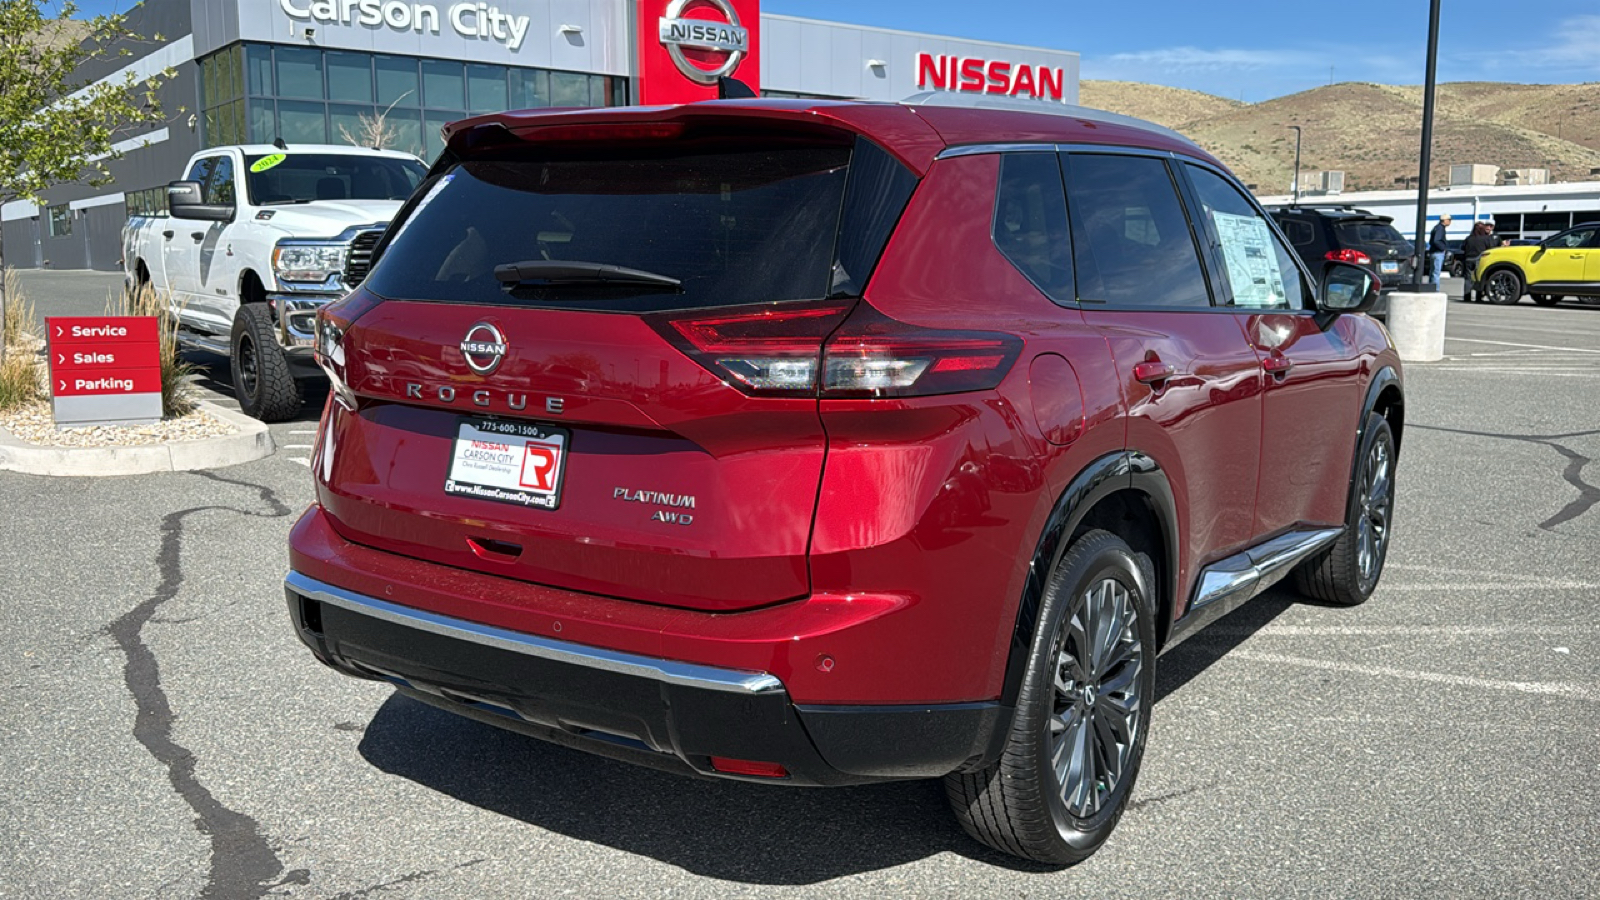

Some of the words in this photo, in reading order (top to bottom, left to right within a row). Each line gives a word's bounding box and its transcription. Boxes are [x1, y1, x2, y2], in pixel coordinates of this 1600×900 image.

[280, 0, 440, 33] Carson
[449, 2, 530, 50] City
[670, 23, 742, 46] NISSAN
[916, 51, 1065, 101] NISSAN
[256, 155, 279, 170] 2024
[71, 324, 128, 337] Service
[460, 341, 505, 355] NISSAN
[73, 351, 115, 364] Sales
[75, 377, 134, 391] Parking
[406, 382, 565, 414] ROGUE
[482, 421, 539, 436] 775-600-1500
[471, 440, 510, 452] NISSAN
[464, 449, 496, 461] CARSON
[497, 453, 515, 464] CITY
[454, 483, 546, 505] www.NissanCarsonCity.com
[613, 486, 696, 509] PLATINUM
[651, 510, 694, 525] AWD
